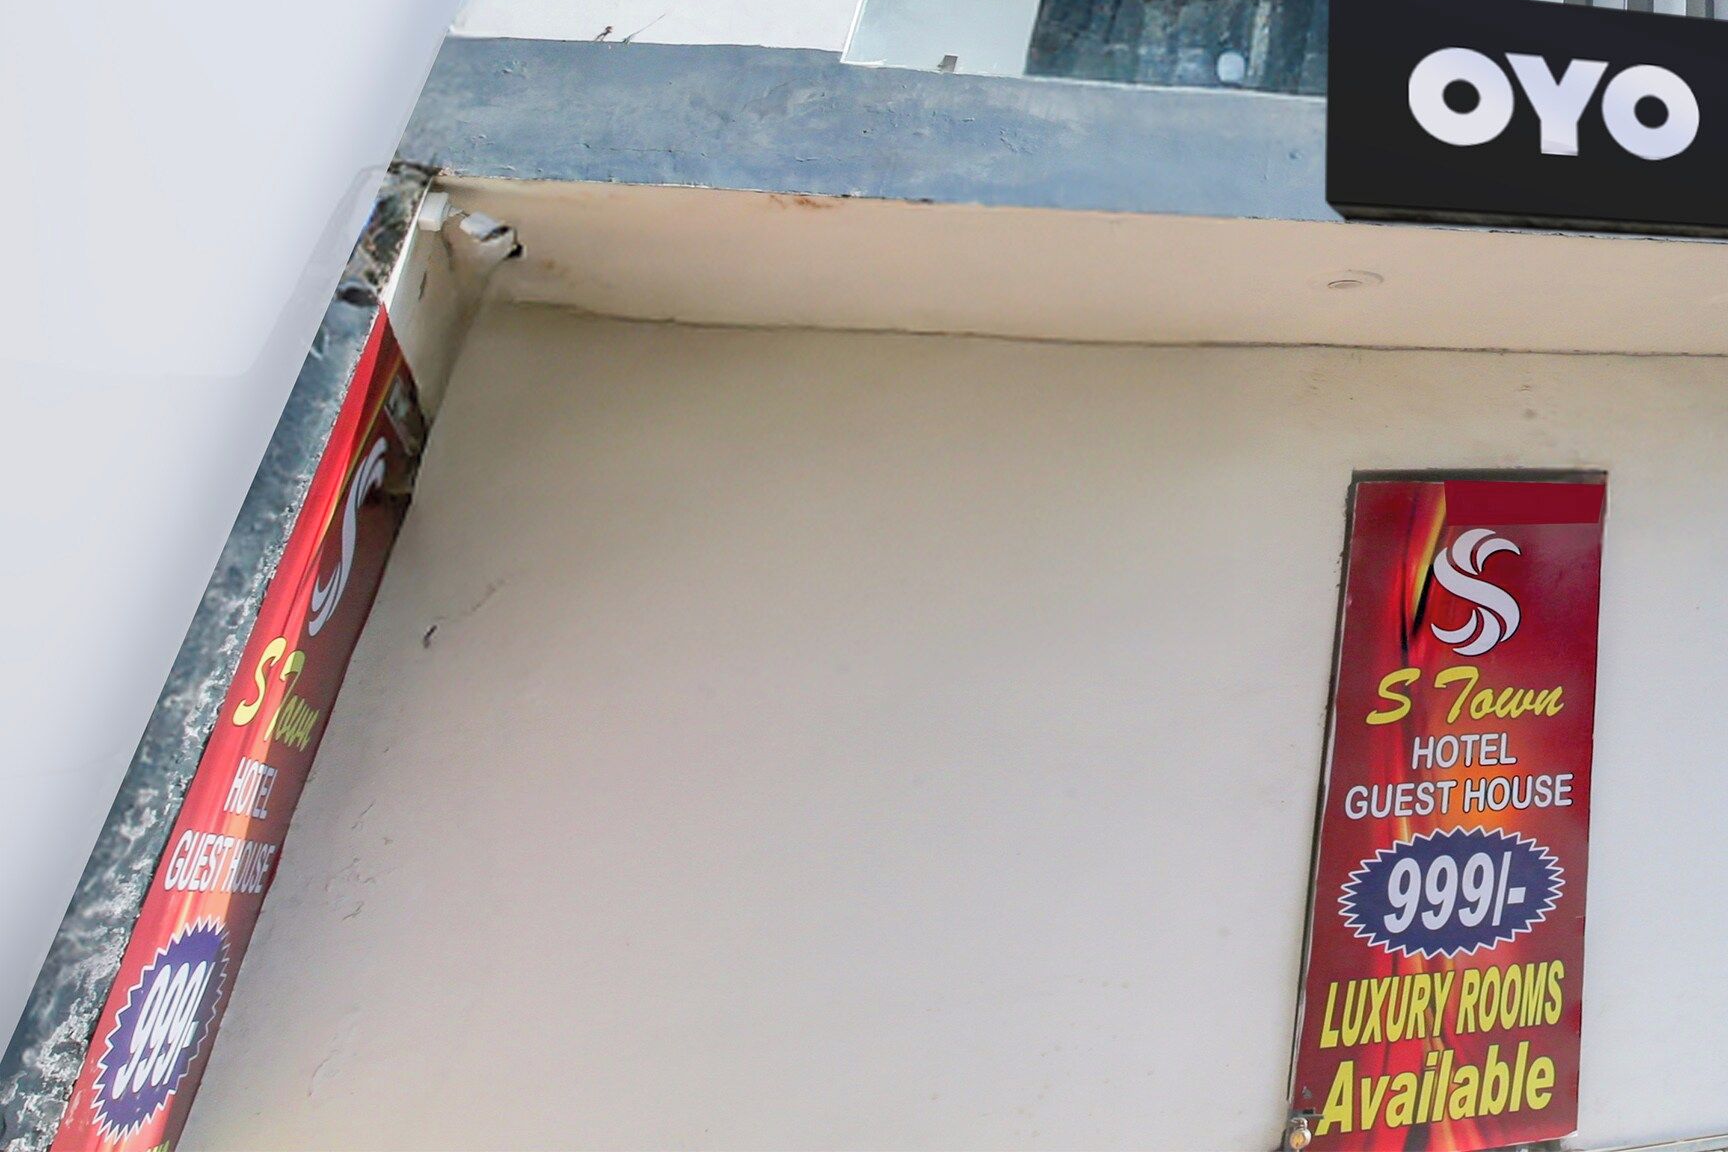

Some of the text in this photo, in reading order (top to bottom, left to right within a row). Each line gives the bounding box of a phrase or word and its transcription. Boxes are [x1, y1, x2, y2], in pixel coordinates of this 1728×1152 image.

[1408, 46, 1700, 161] OYO
[232, 636, 288, 727] S
[1365, 665, 1564, 725] S Town
[223, 756, 278, 820] HOTEL
[1411, 732, 1517, 769] HOTEL
[1345, 773, 1574, 820] GUEST HOUSE
[164, 829, 276, 894] GUEST HOUSE
[1383, 851, 1526, 934] 999/-
[112, 960, 216, 1100] 999/-
[1319, 959, 1566, 1049] LUXURY ROOMS
[1315, 1041, 1556, 1136] Available
